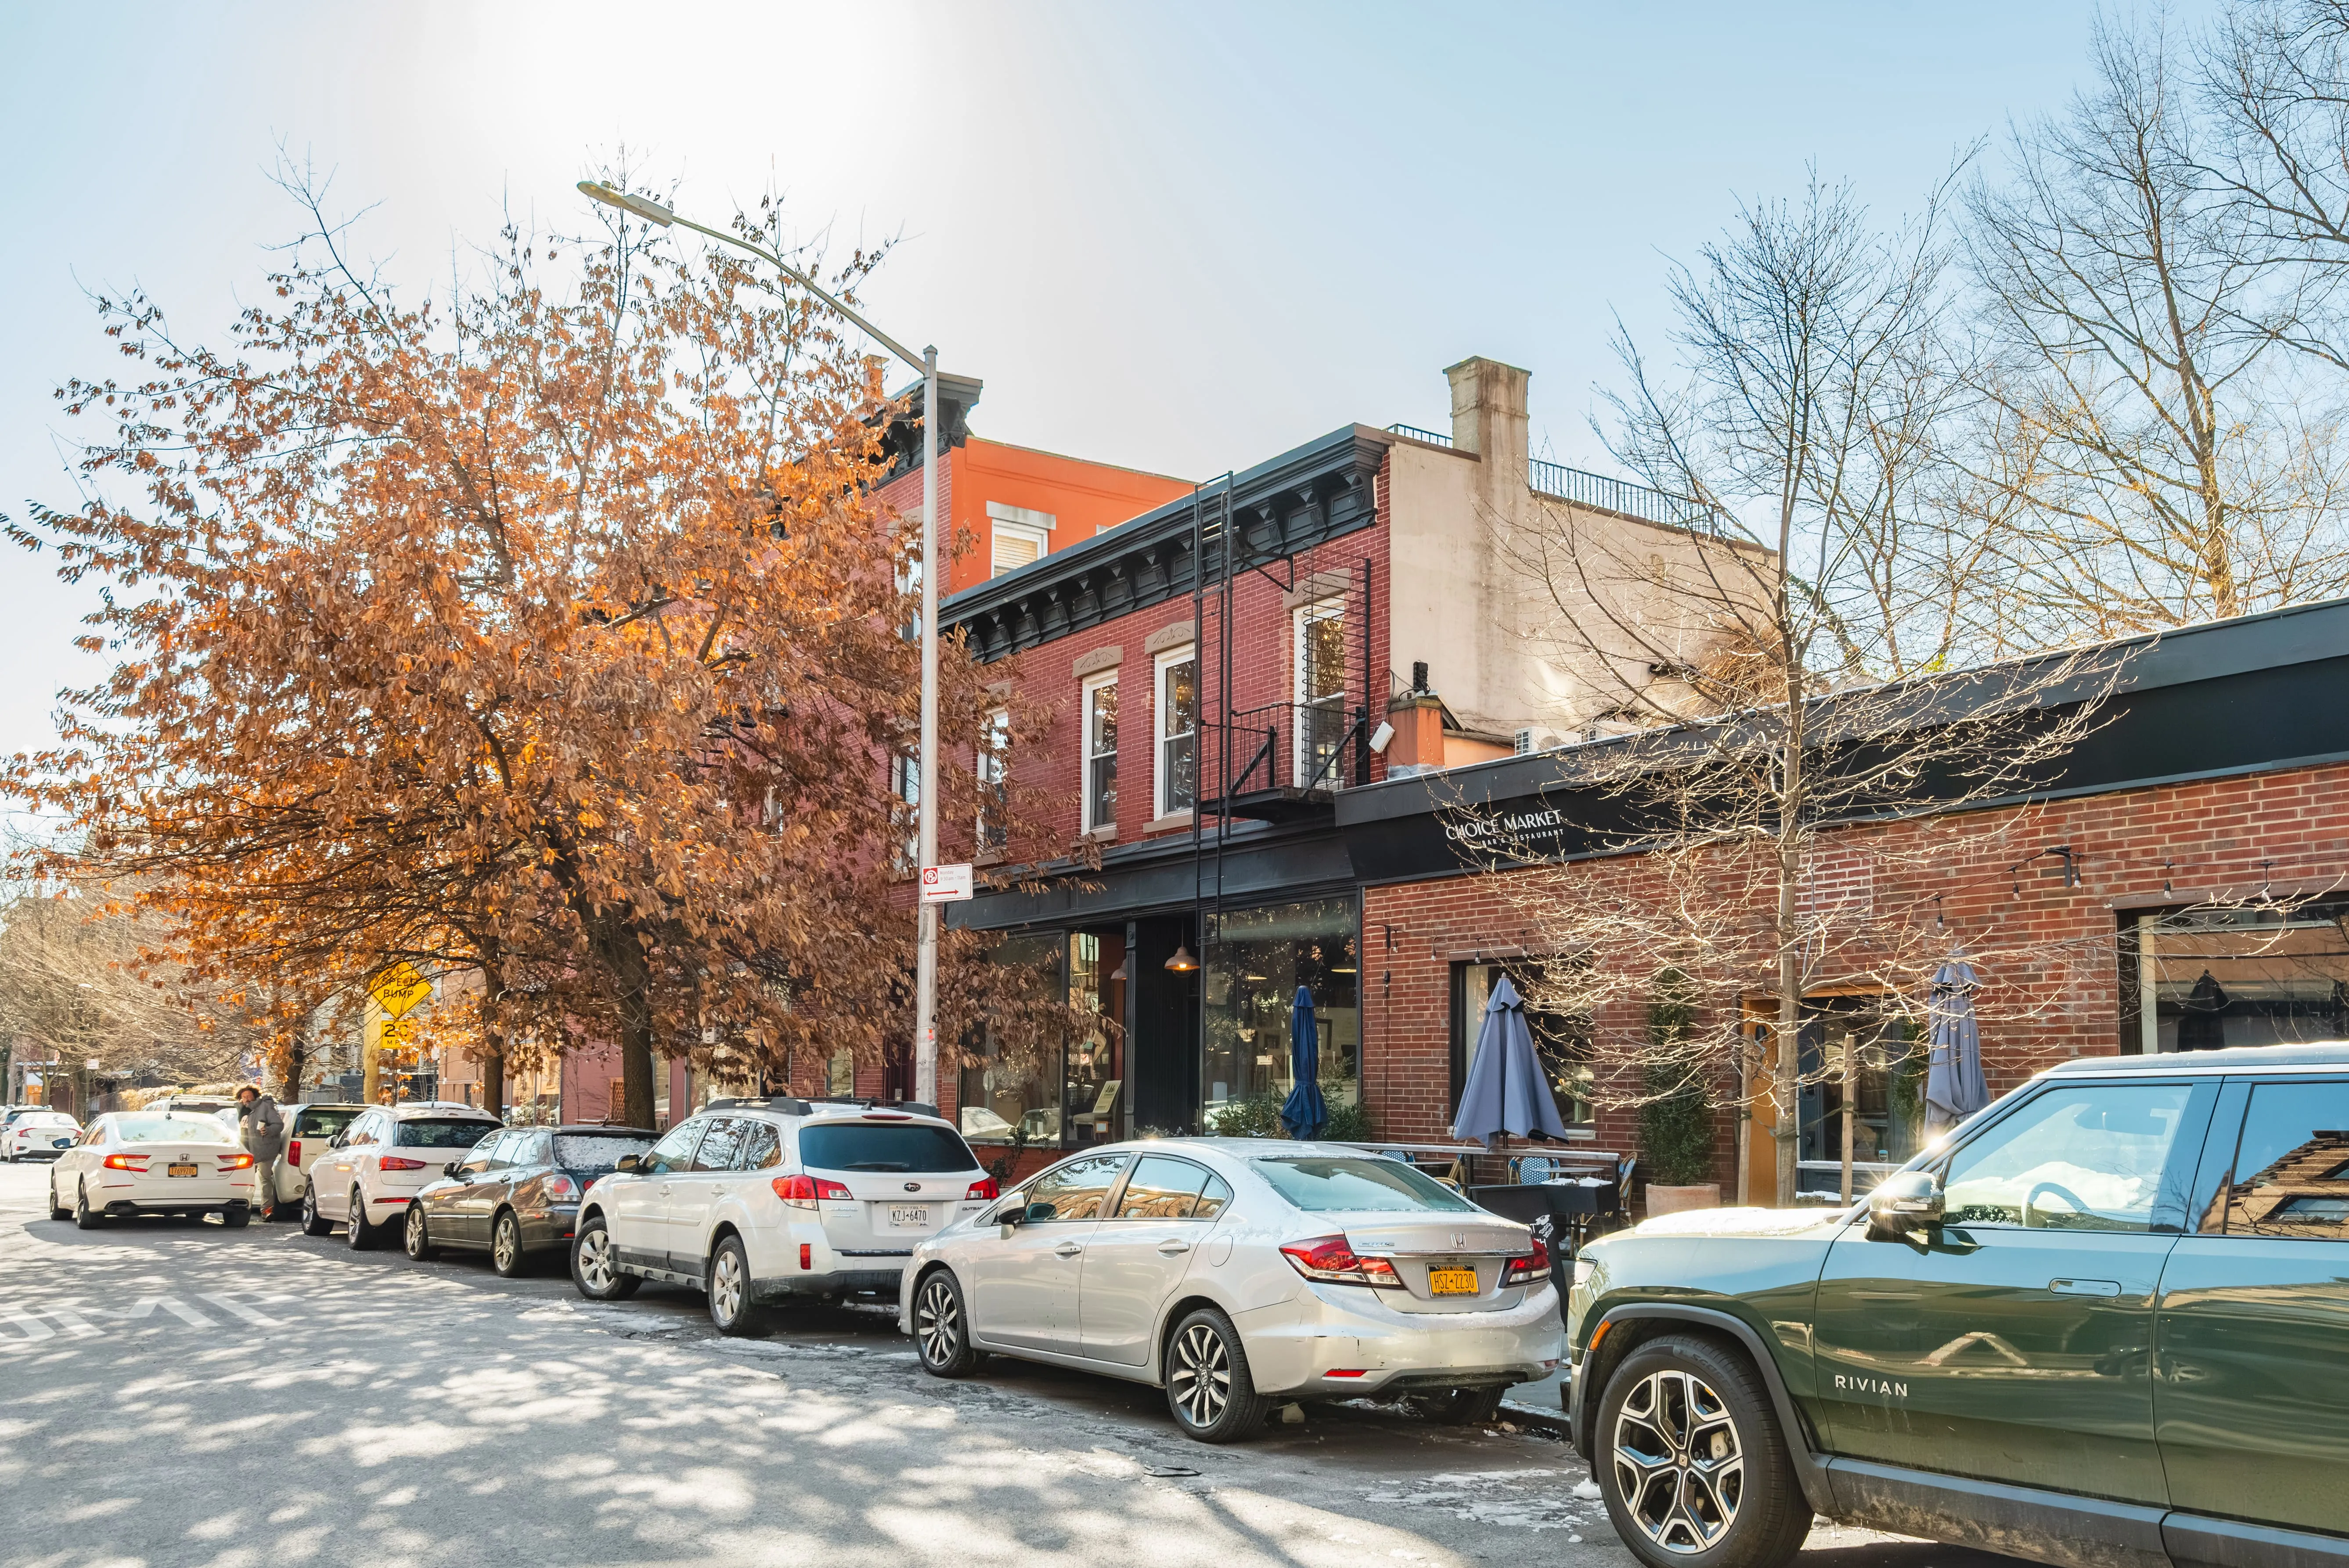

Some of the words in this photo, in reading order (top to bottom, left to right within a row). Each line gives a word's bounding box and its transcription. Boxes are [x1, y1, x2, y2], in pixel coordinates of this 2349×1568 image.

[1446, 819, 1499, 840] CHOICE
[1504, 810, 1561, 830] MARKET
[383, 977, 416, 987] SPED
[384, 989, 414, 998] BUMP
[892, 1210, 905, 1221] KZJ
[910, 1210, 926, 1221] 6470
[1434, 1273, 1450, 1290] HSZ
[1454, 1273, 1474, 1289] 2230
[1835, 1375, 1907, 1397] RIVIAN
